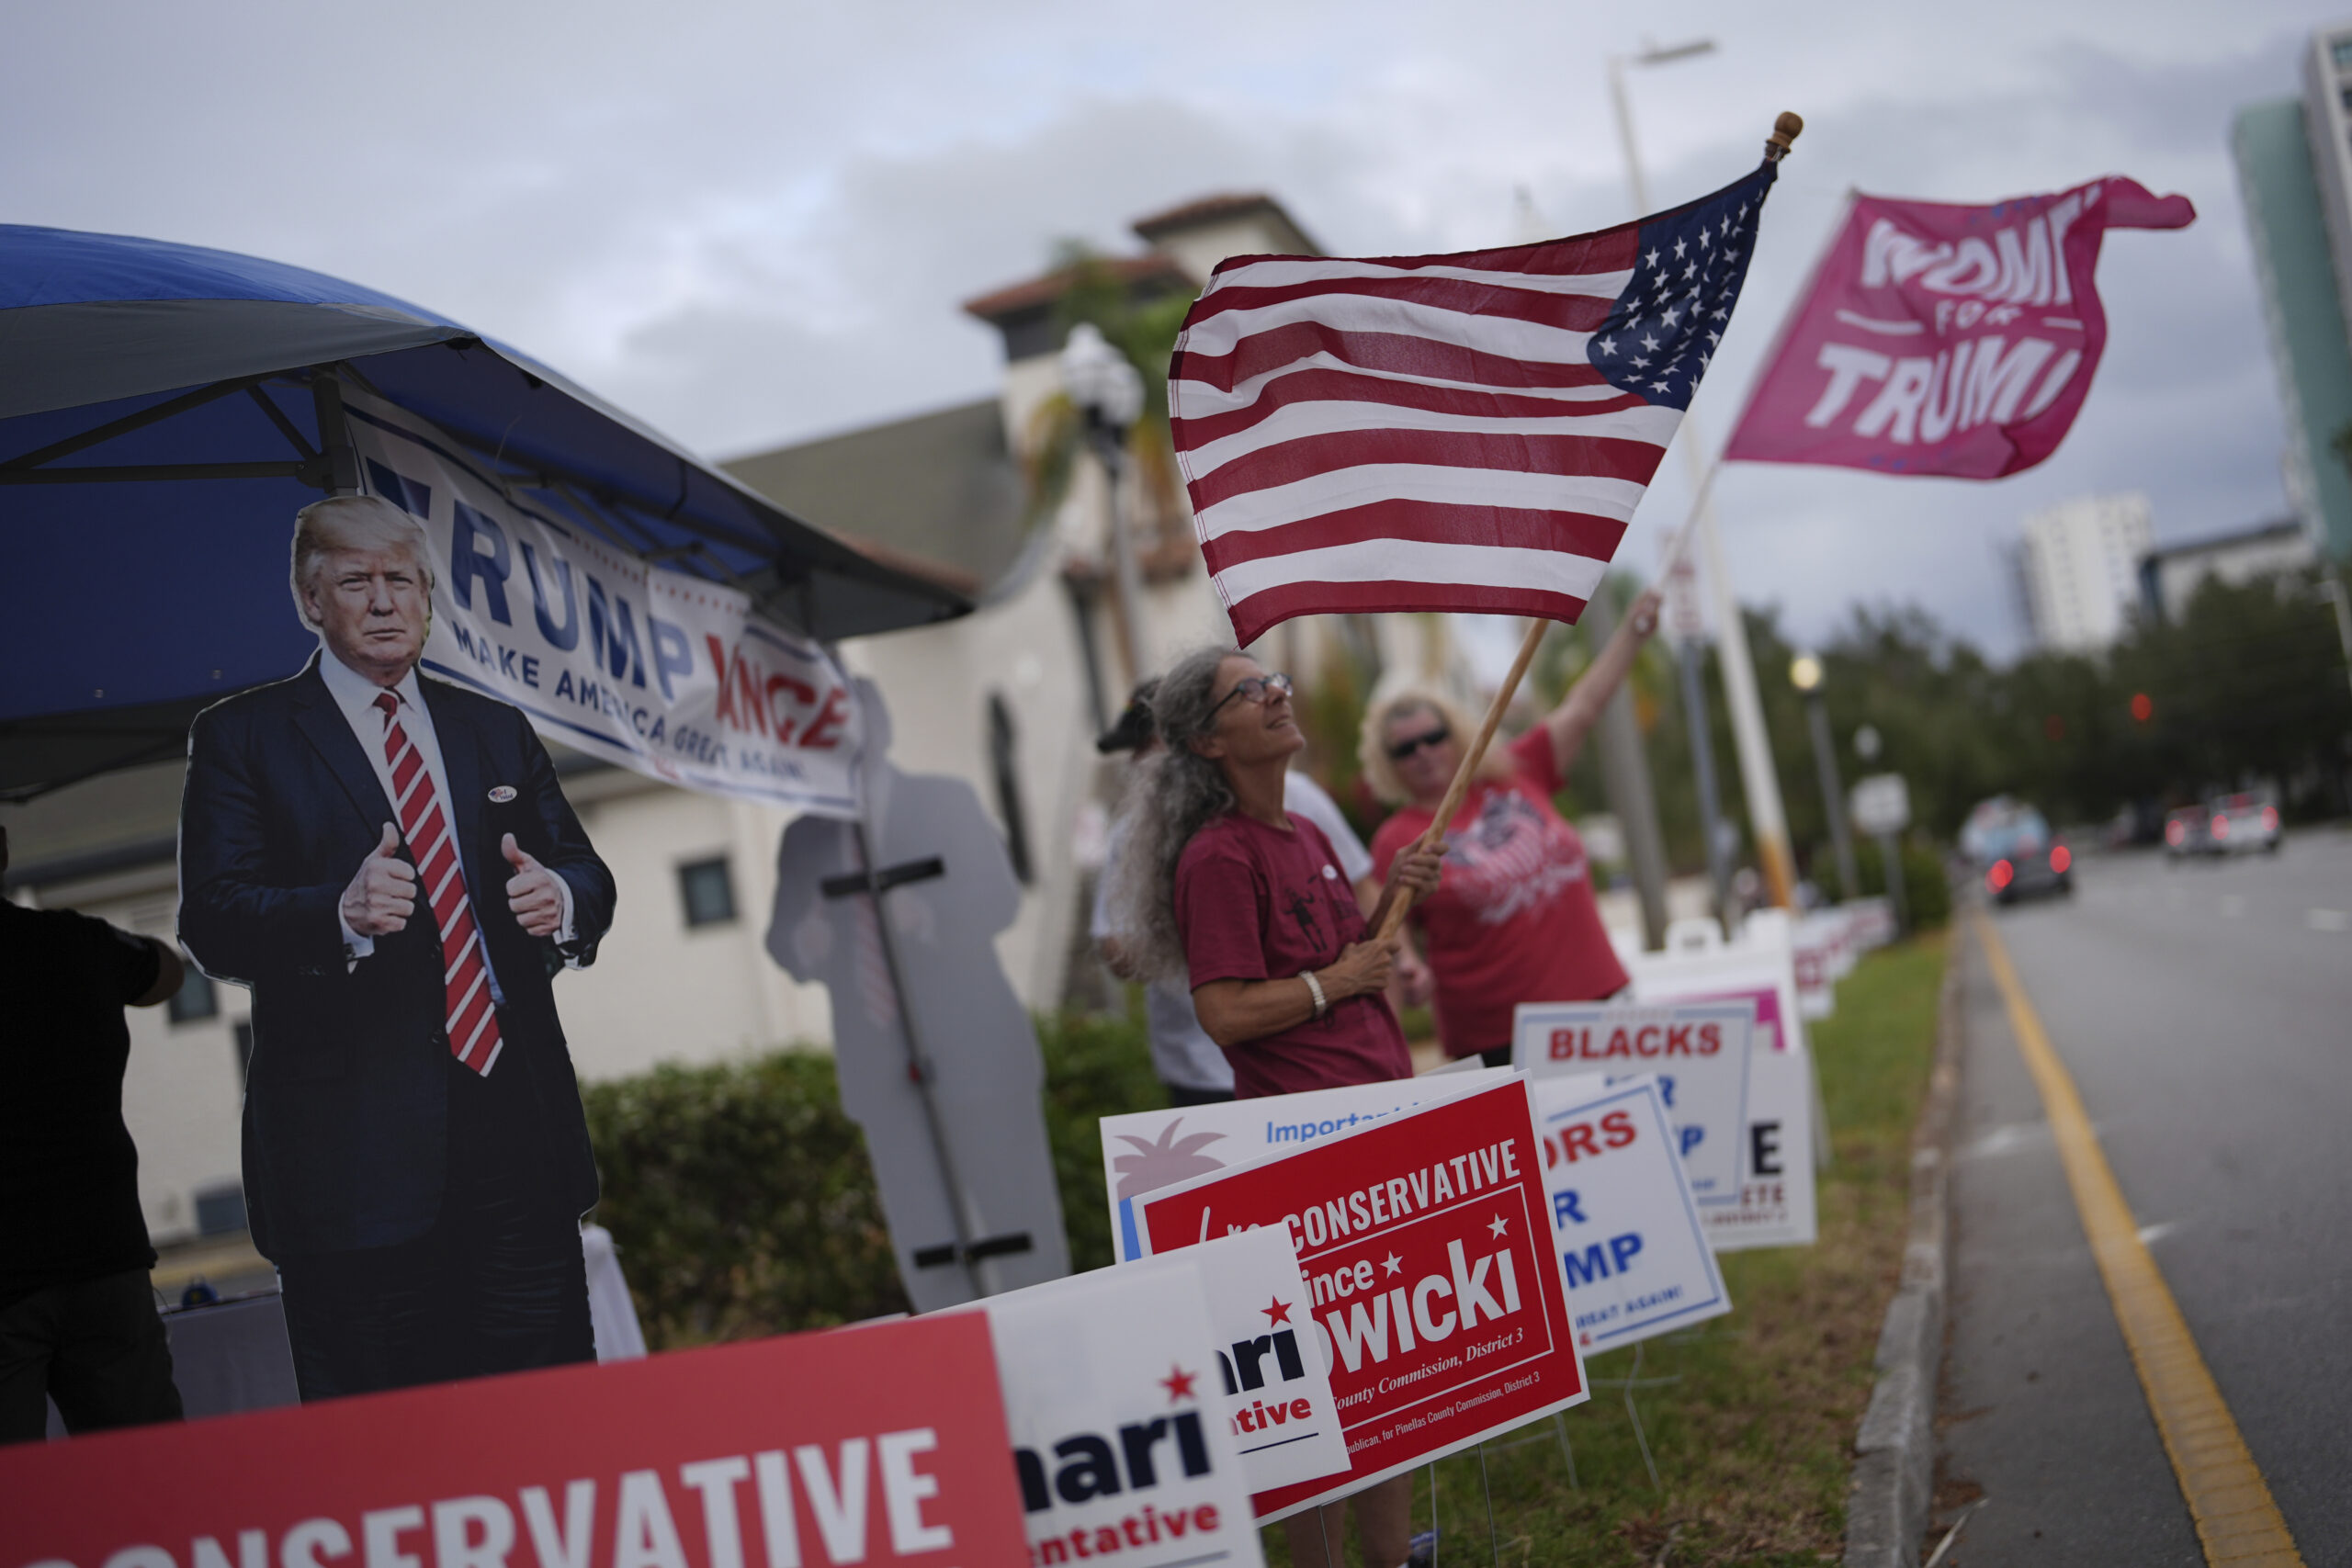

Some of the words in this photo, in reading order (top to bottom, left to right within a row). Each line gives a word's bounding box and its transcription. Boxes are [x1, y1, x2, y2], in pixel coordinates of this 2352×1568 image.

[452, 620, 540, 688] MAKE
[674, 728, 729, 767] GREAT
[1547, 1022, 1723, 1062] BLACKS
[1266, 1106, 1401, 1144] Import
[1282, 1138, 1521, 1252] CONSERVATIVE
[1378, 1357, 1463, 1394] Commission,
[1465, 1332, 1513, 1362] District
[1516, 1326, 1524, 1343] 3
[1228, 1397, 1312, 1436] tive
[1382, 1428, 1394, 1441] for
[1395, 1416, 1427, 1437] Pinellas
[1428, 1405, 1454, 1424] County
[1456, 1388, 1504, 1414] Commission,
[1504, 1375, 1533, 1393] District
[1534, 1371, 1541, 1382] 3
[18, 1427, 953, 1568] ERVATIVE
[1029, 1503, 1220, 1566] ntative
